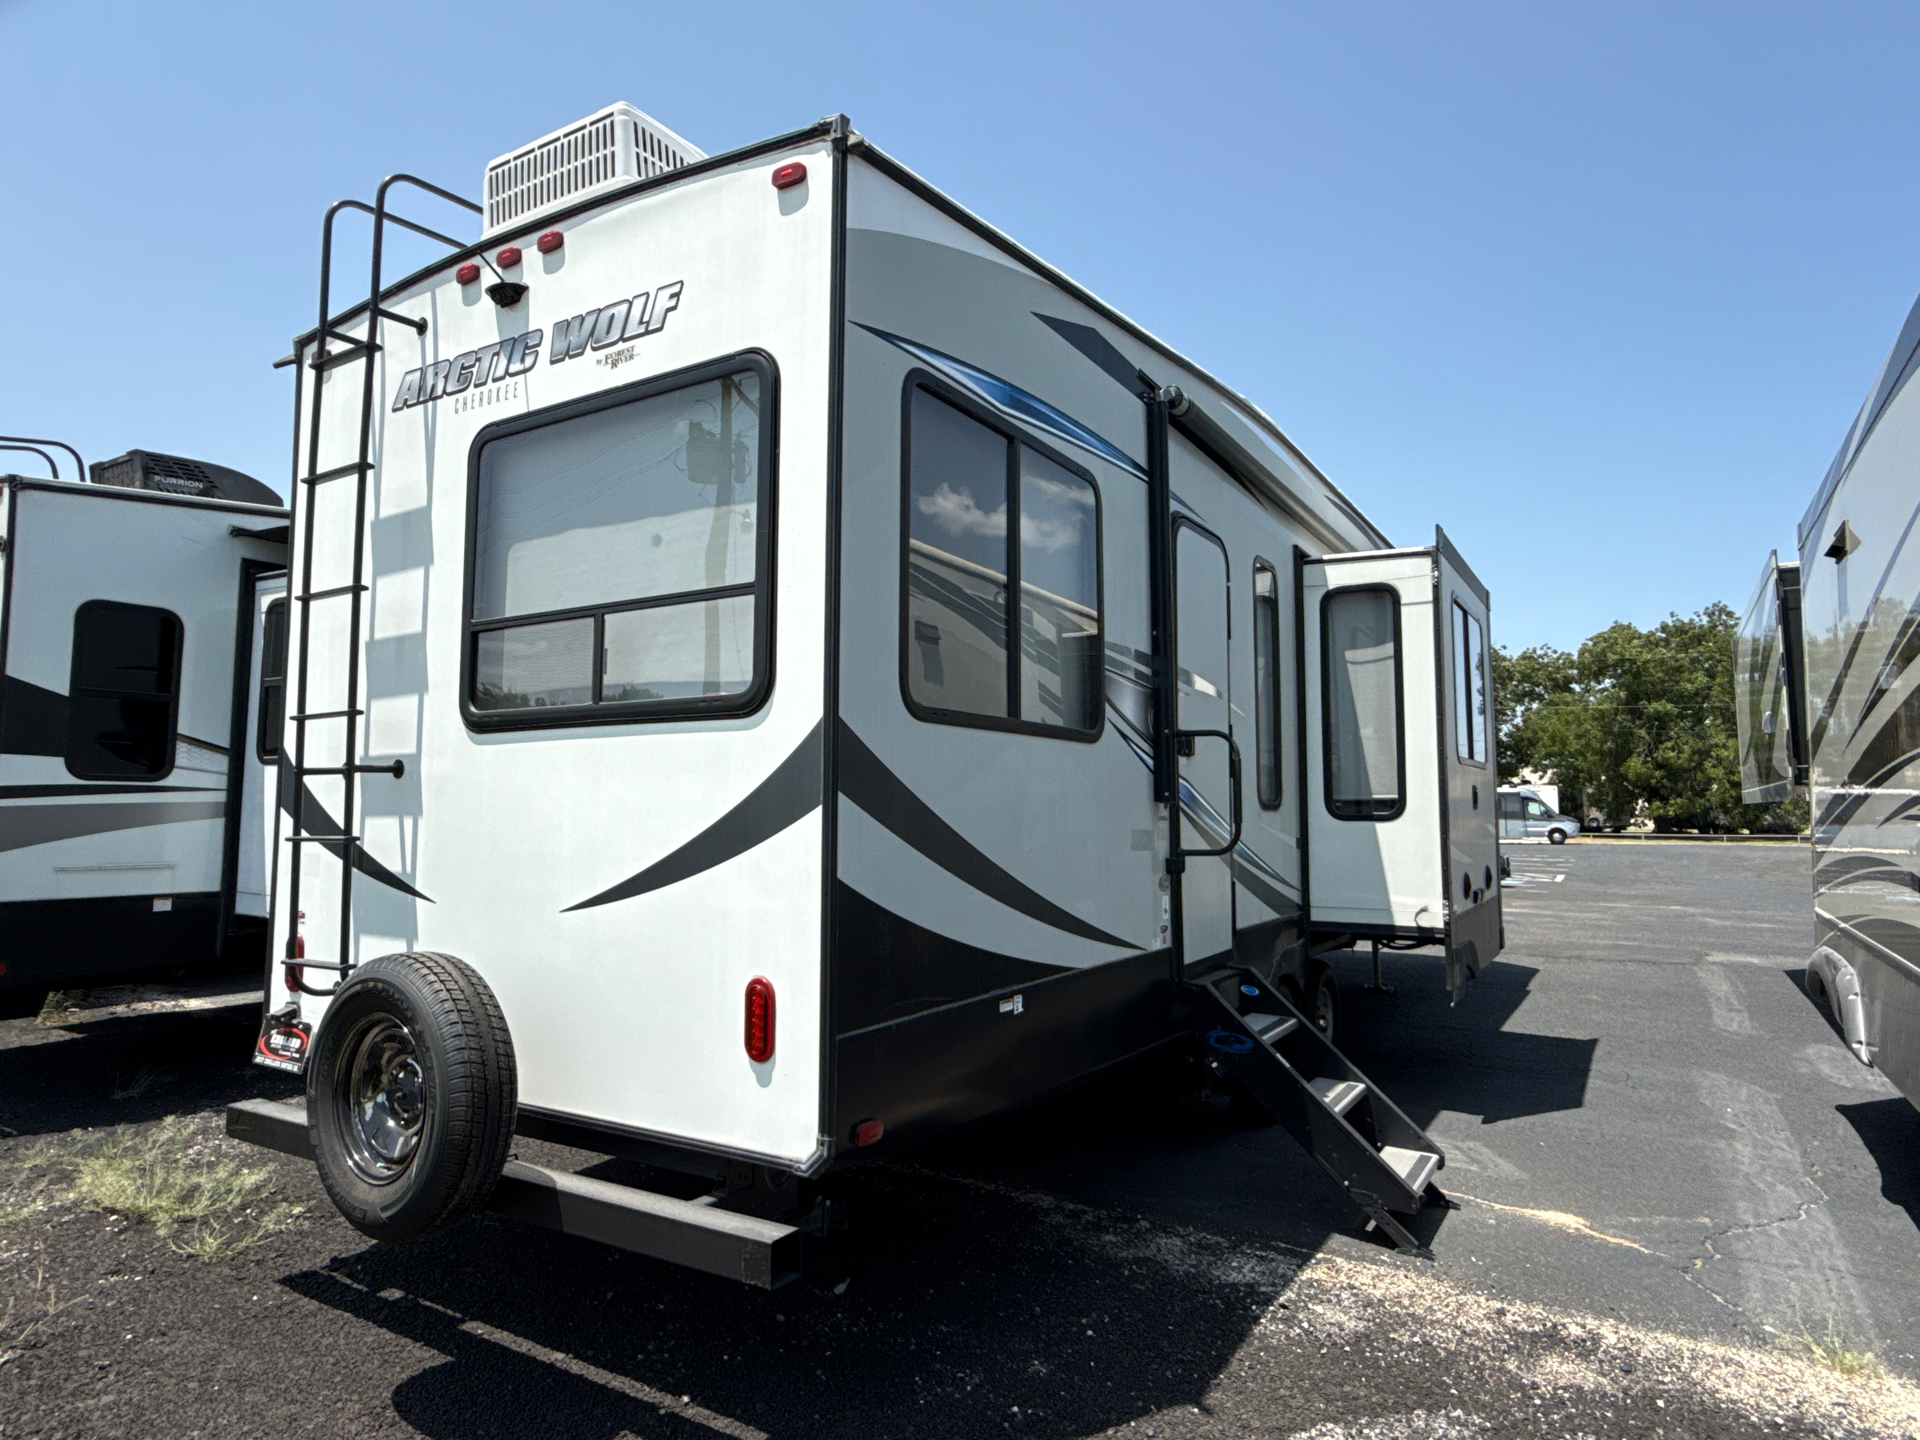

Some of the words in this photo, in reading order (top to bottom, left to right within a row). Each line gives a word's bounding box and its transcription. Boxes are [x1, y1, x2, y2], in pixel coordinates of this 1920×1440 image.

[391, 329, 543, 413] ARCTIC
[549, 279, 684, 365] WOLF
[603, 345, 636, 366] FOREST
[610, 352, 636, 371] RIVER
[454, 382, 518, 414] CHEROKEE
[154, 475, 203, 489] FURRION
